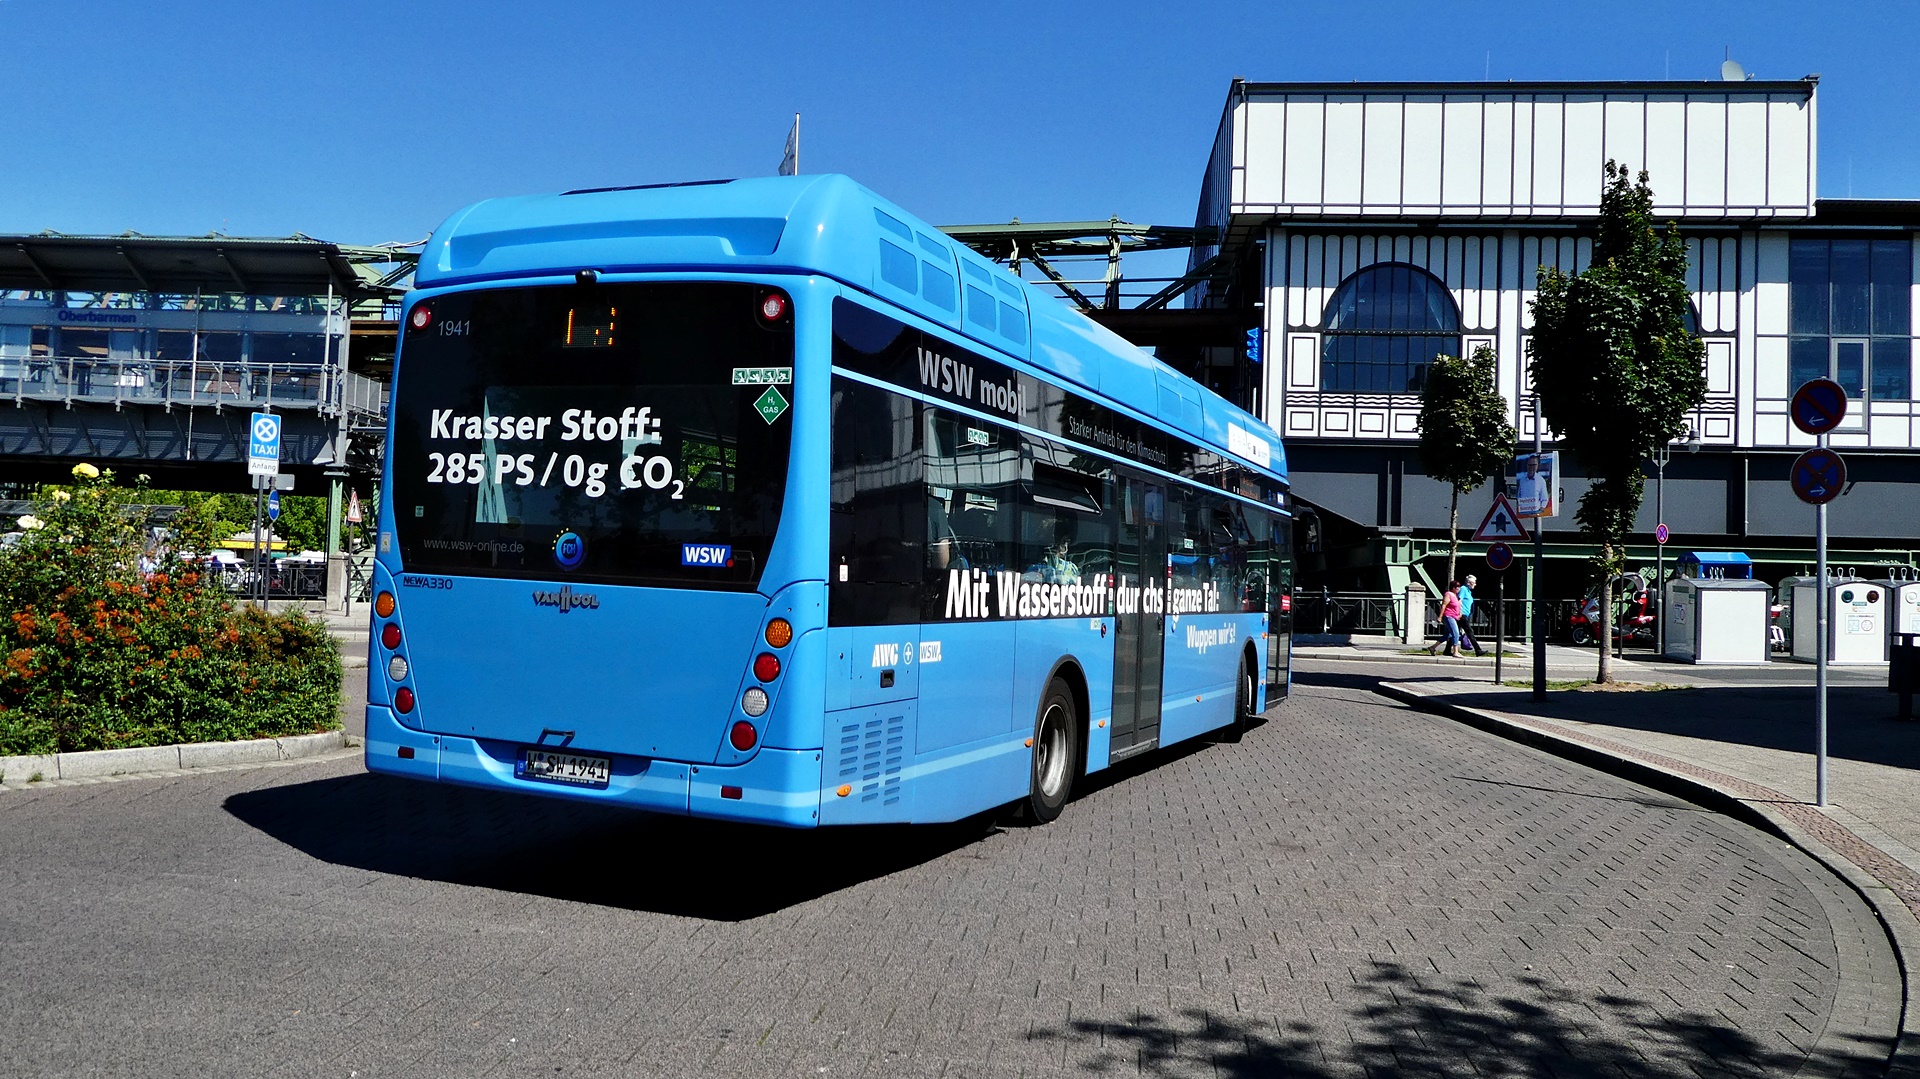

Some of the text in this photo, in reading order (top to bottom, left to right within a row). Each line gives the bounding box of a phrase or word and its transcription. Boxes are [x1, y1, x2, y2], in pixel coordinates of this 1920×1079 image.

[58, 310, 137, 323] Oberbarmen
[437, 320, 470, 336] 1941
[917, 347, 1027, 418] WSW mobil
[430, 406, 662, 441] Krasser Stoff:
[253, 443, 277, 456] TAXI
[1069, 415, 1167, 465] Starker Antrieb für den Klimaschutz
[251, 462, 276, 471] Anfang
[427, 452, 486, 484] 285
[495, 453, 536, 486] PS
[563, 454, 609, 498] 0g
[423, 538, 524, 553] www.wsw-online.de
[685, 546, 726, 563] WSW
[945, 567, 991, 618] Mit
[996, 571, 1108, 618] Wasserstoff
[1172, 588, 1203, 622] ganze
[920, 644, 939, 659] WSW
[1187, 625, 1217, 654] Wuppen
[872, 643, 898, 667] AWG
[527, 752, 537, 772] W
[546, 755, 566, 774] SW
[569, 758, 606, 780] 1941
